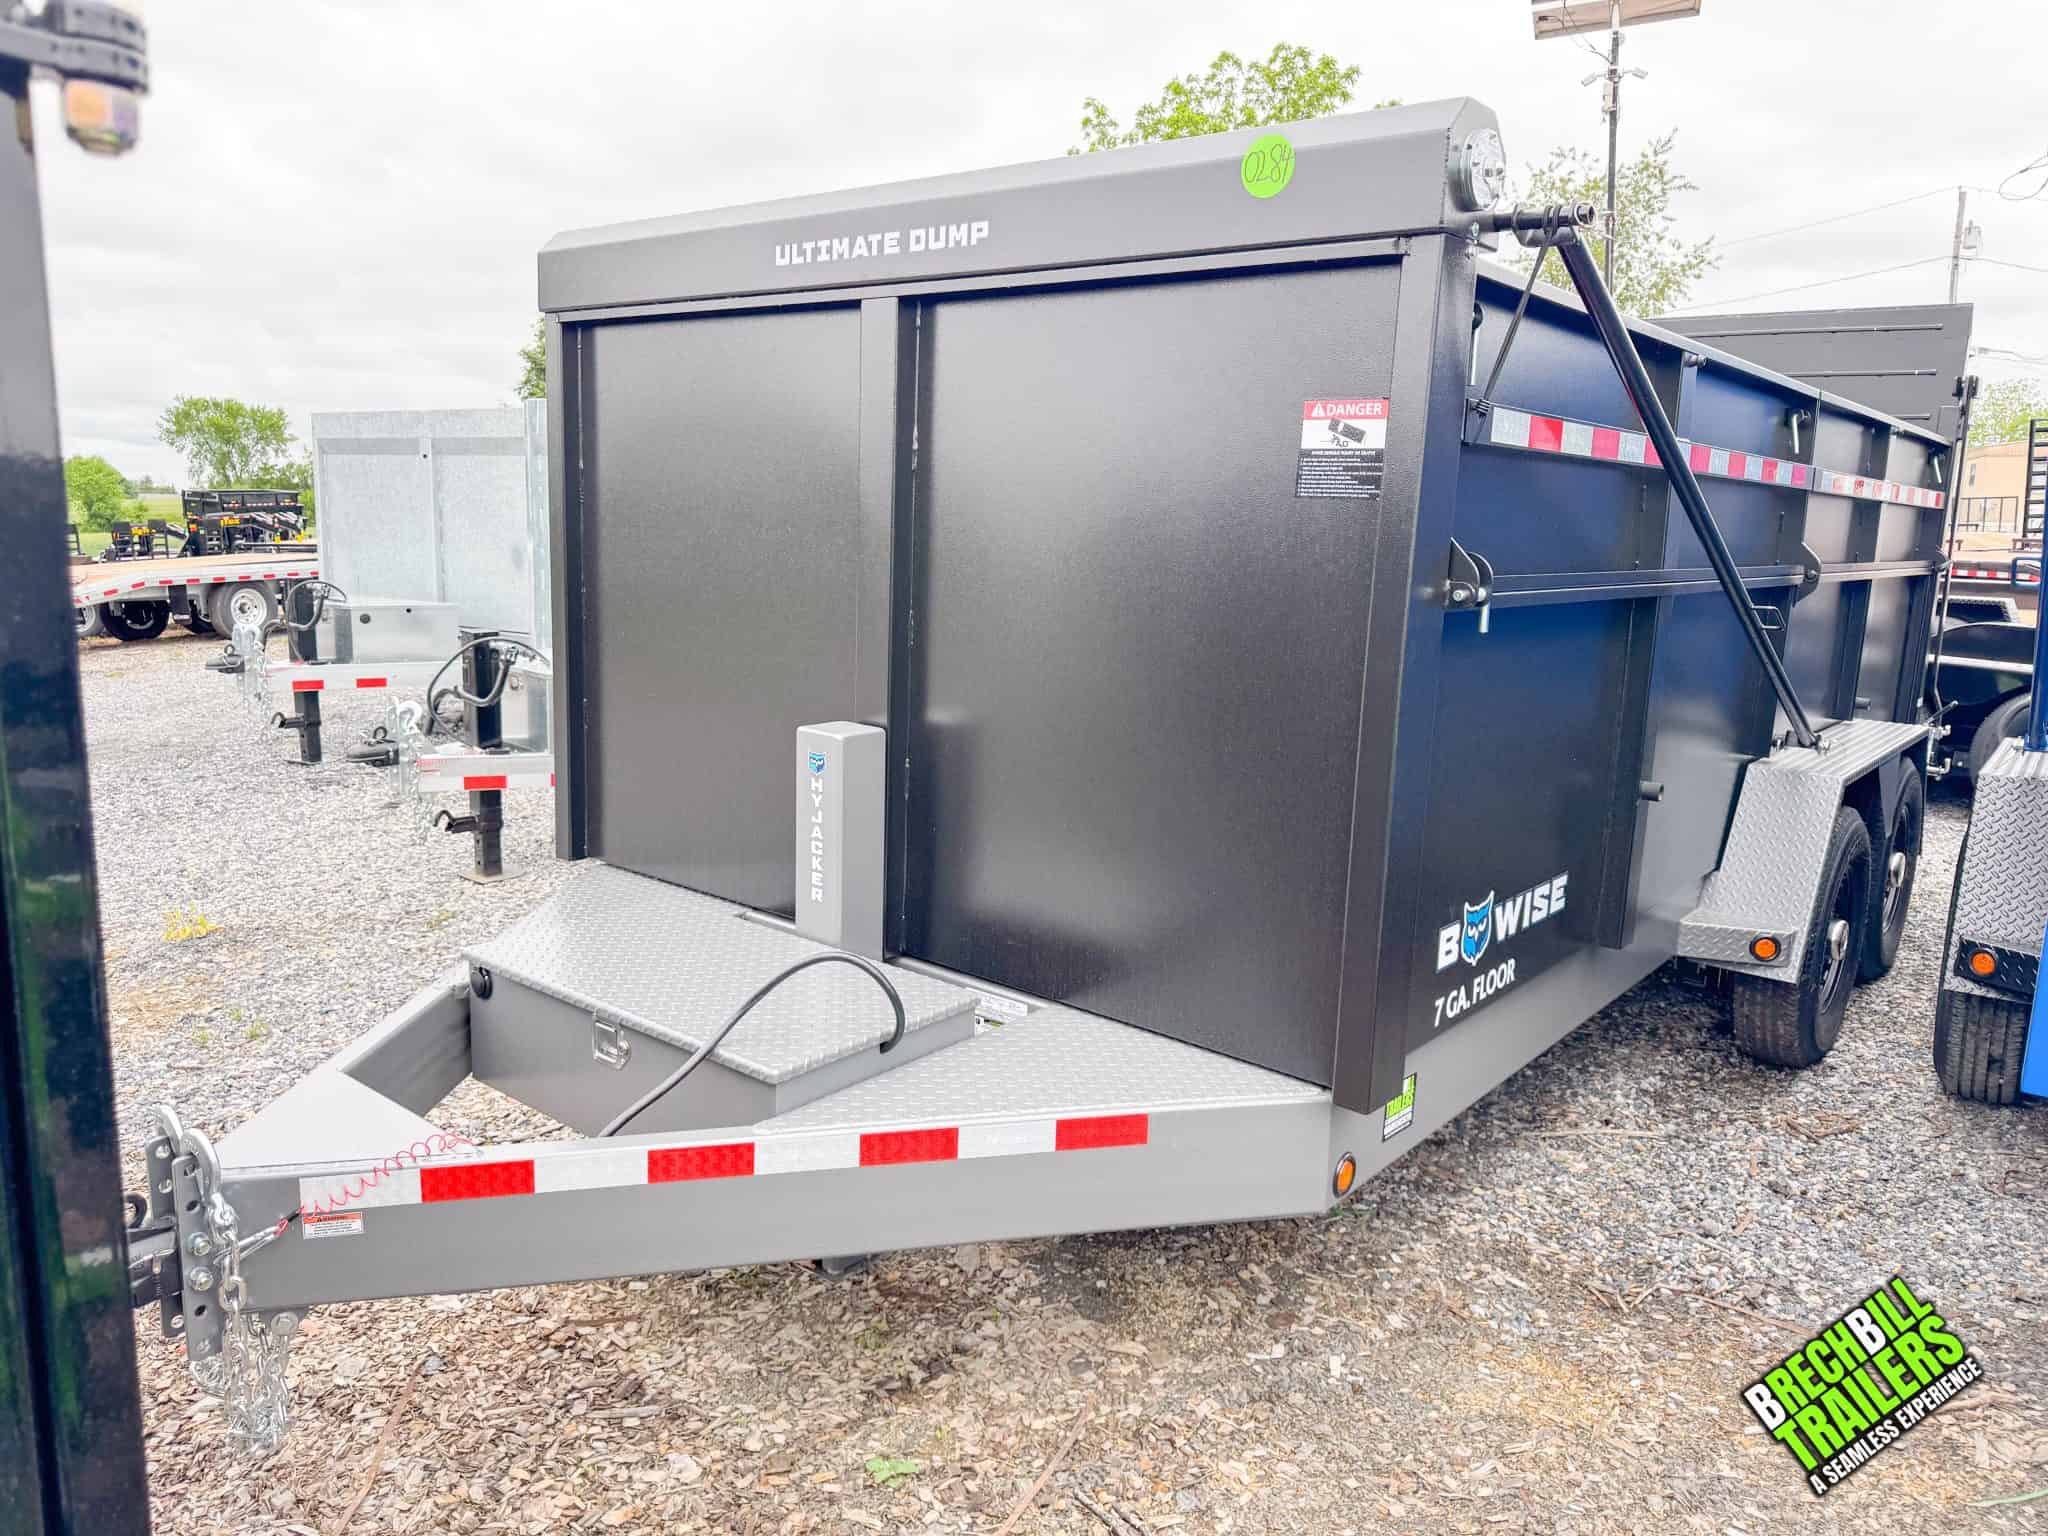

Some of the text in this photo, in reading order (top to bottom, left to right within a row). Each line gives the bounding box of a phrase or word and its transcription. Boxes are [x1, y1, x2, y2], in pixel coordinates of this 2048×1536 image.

[775, 220, 989, 266] ULTIMATE DUMP
[1326, 403, 1383, 416] DANGER
[810, 777, 824, 902] HYJACKER
[1434, 957, 1516, 1028] 7 GA. FLOOR
